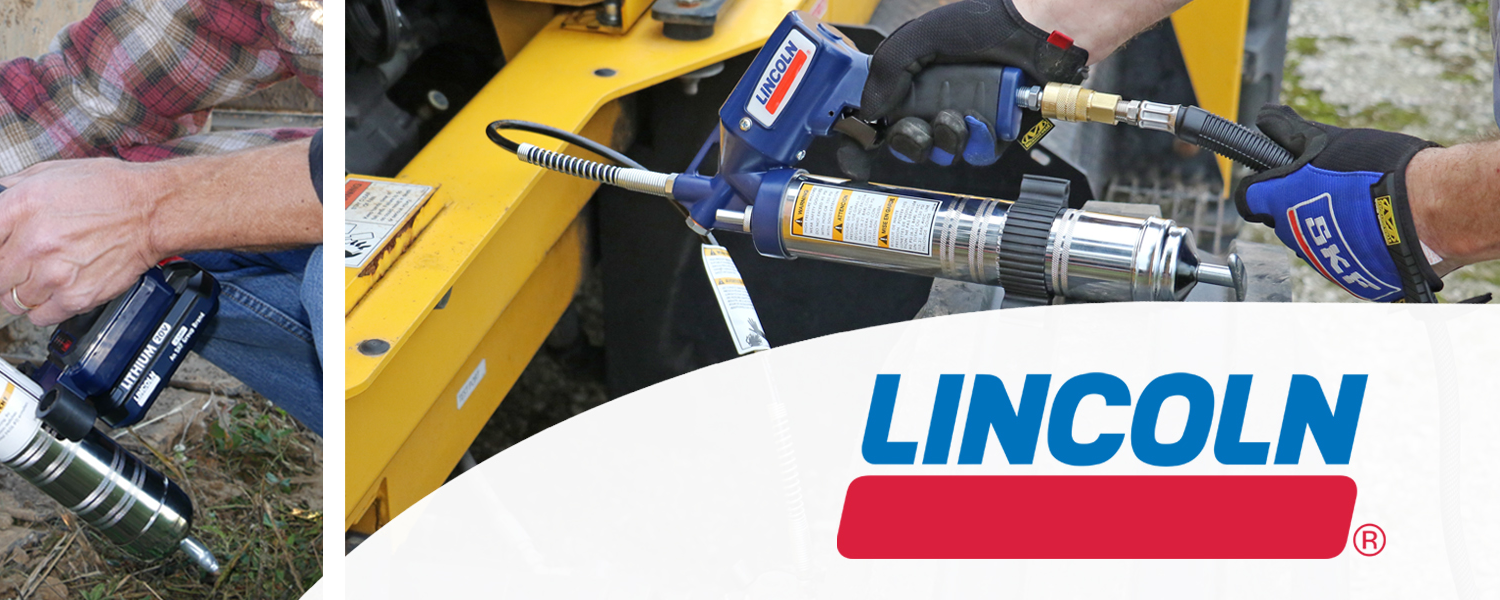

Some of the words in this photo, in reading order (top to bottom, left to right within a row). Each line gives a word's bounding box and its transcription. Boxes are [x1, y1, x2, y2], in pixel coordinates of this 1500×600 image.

[756, 40, 798, 105] LINCOLN
[797, 189, 809, 215] WARNING
[886, 198, 896, 213] GARDE
[1305, 216, 1381, 290] SKF
[192, 312, 205, 328] Brand
[120, 344, 157, 390] LITHIUM
[154, 324, 168, 342] 20V
[133, 370, 156, 402] LINCOLN
